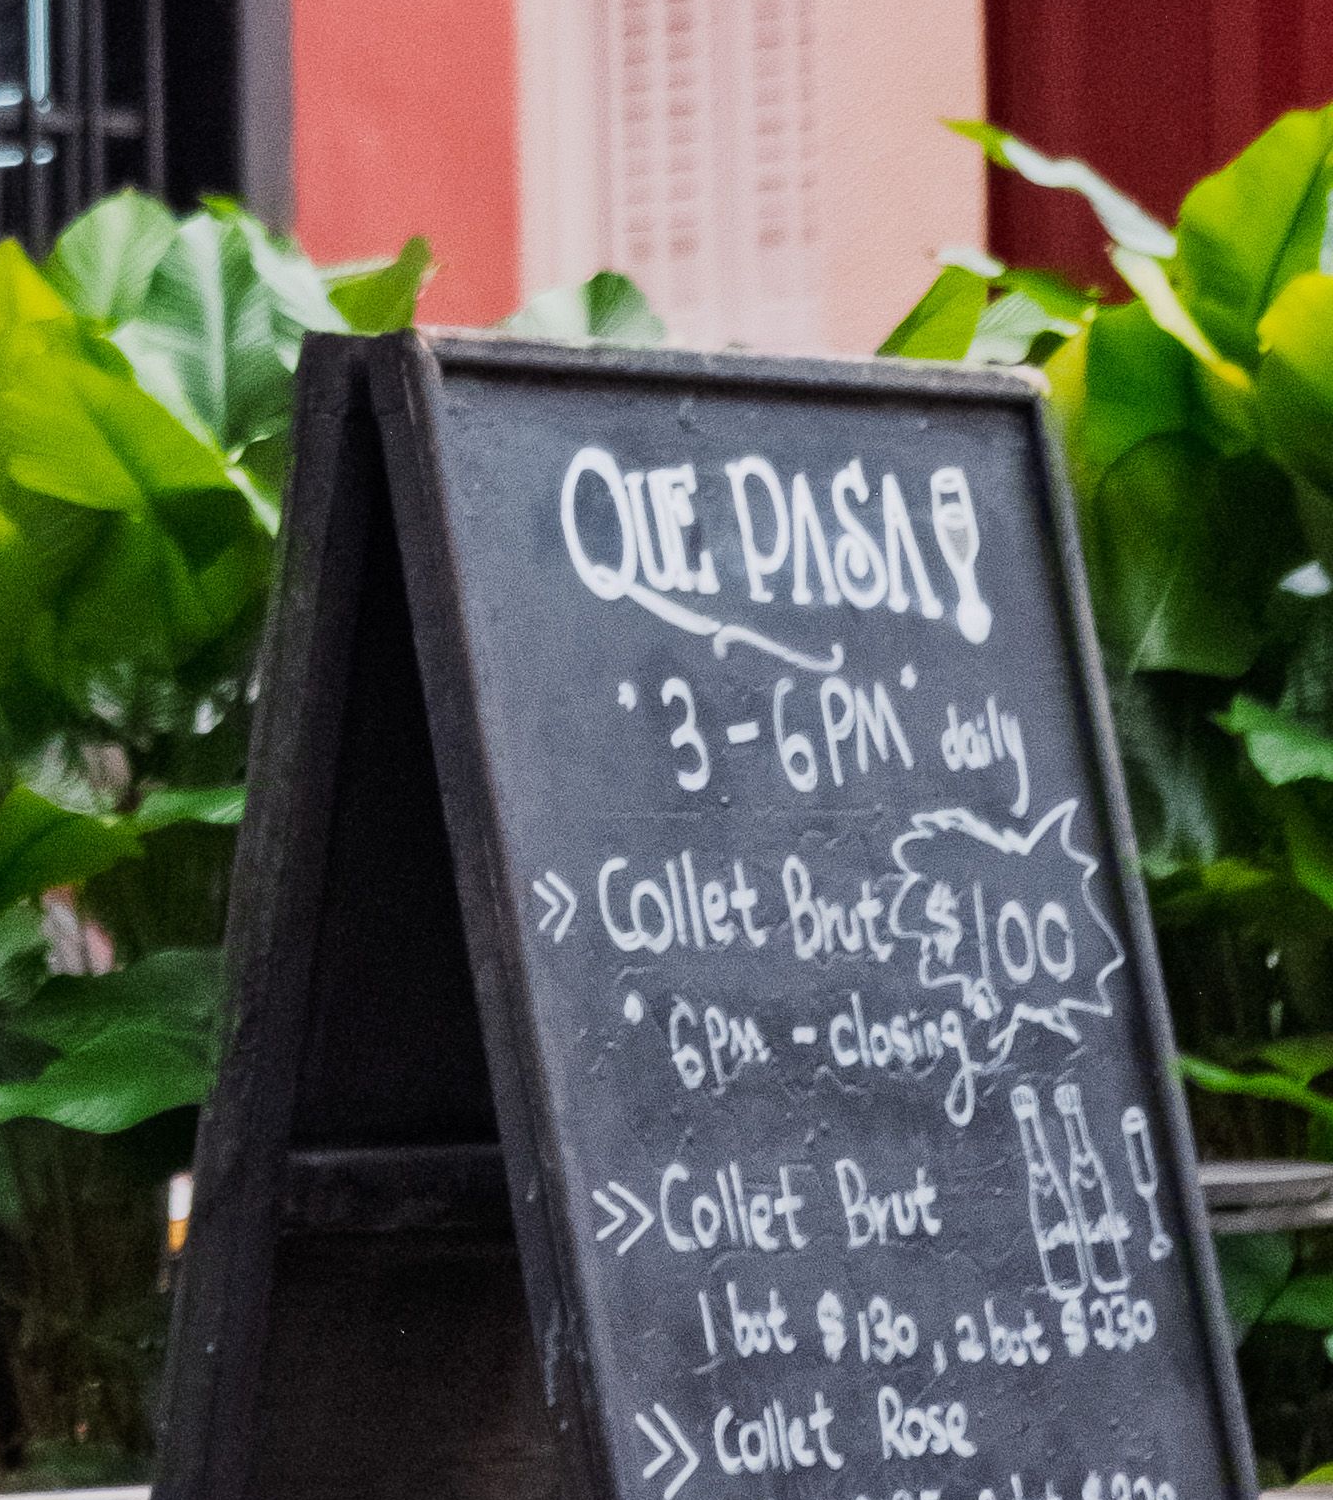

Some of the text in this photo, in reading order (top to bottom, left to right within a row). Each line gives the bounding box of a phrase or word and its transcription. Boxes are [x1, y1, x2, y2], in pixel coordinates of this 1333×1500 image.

[561, 446, 720, 632] QUE
[940, 697, 1030, 817] daily
[597, 850, 1076, 983] Collet Brut $100
[669, 998, 772, 1095] 6PM
[830, 991, 976, 1127] closing
[659, 1157, 941, 1252] Collet Brut
[727, 1280, 797, 1358] bot
[985, 1298, 1052, 1367] bot
[714, 1386, 978, 1475] Collet Rose
